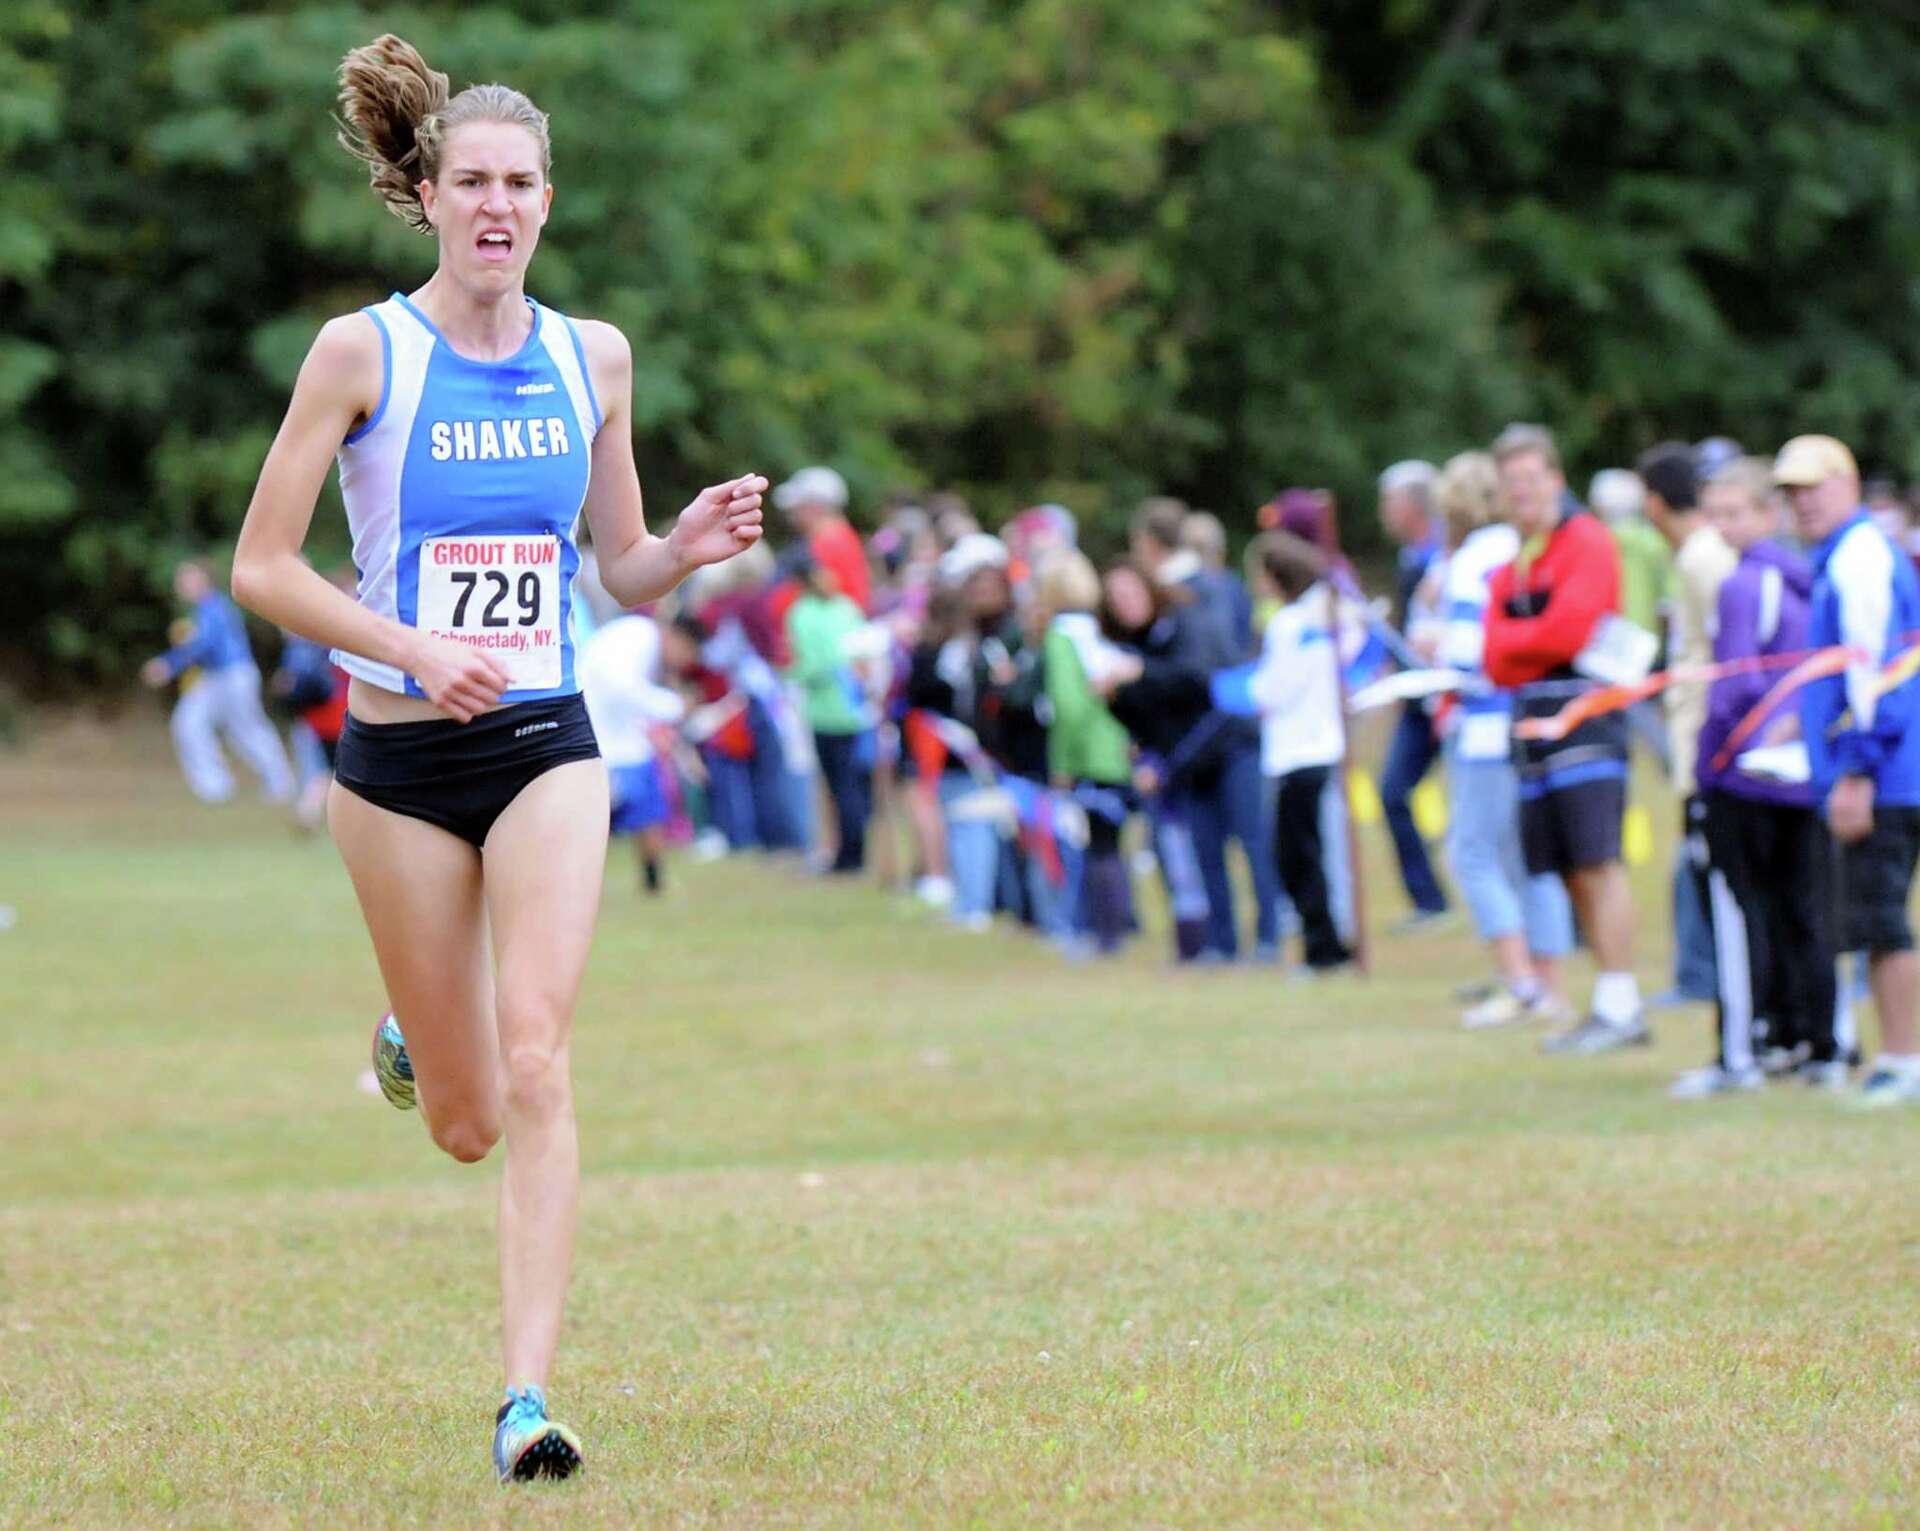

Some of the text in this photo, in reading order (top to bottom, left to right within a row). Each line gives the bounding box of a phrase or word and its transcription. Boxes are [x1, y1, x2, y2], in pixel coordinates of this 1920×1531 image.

[431, 417, 569, 460] SHAKER
[434, 543, 555, 565] GROUT RUN
[451, 570, 540, 627] 729
